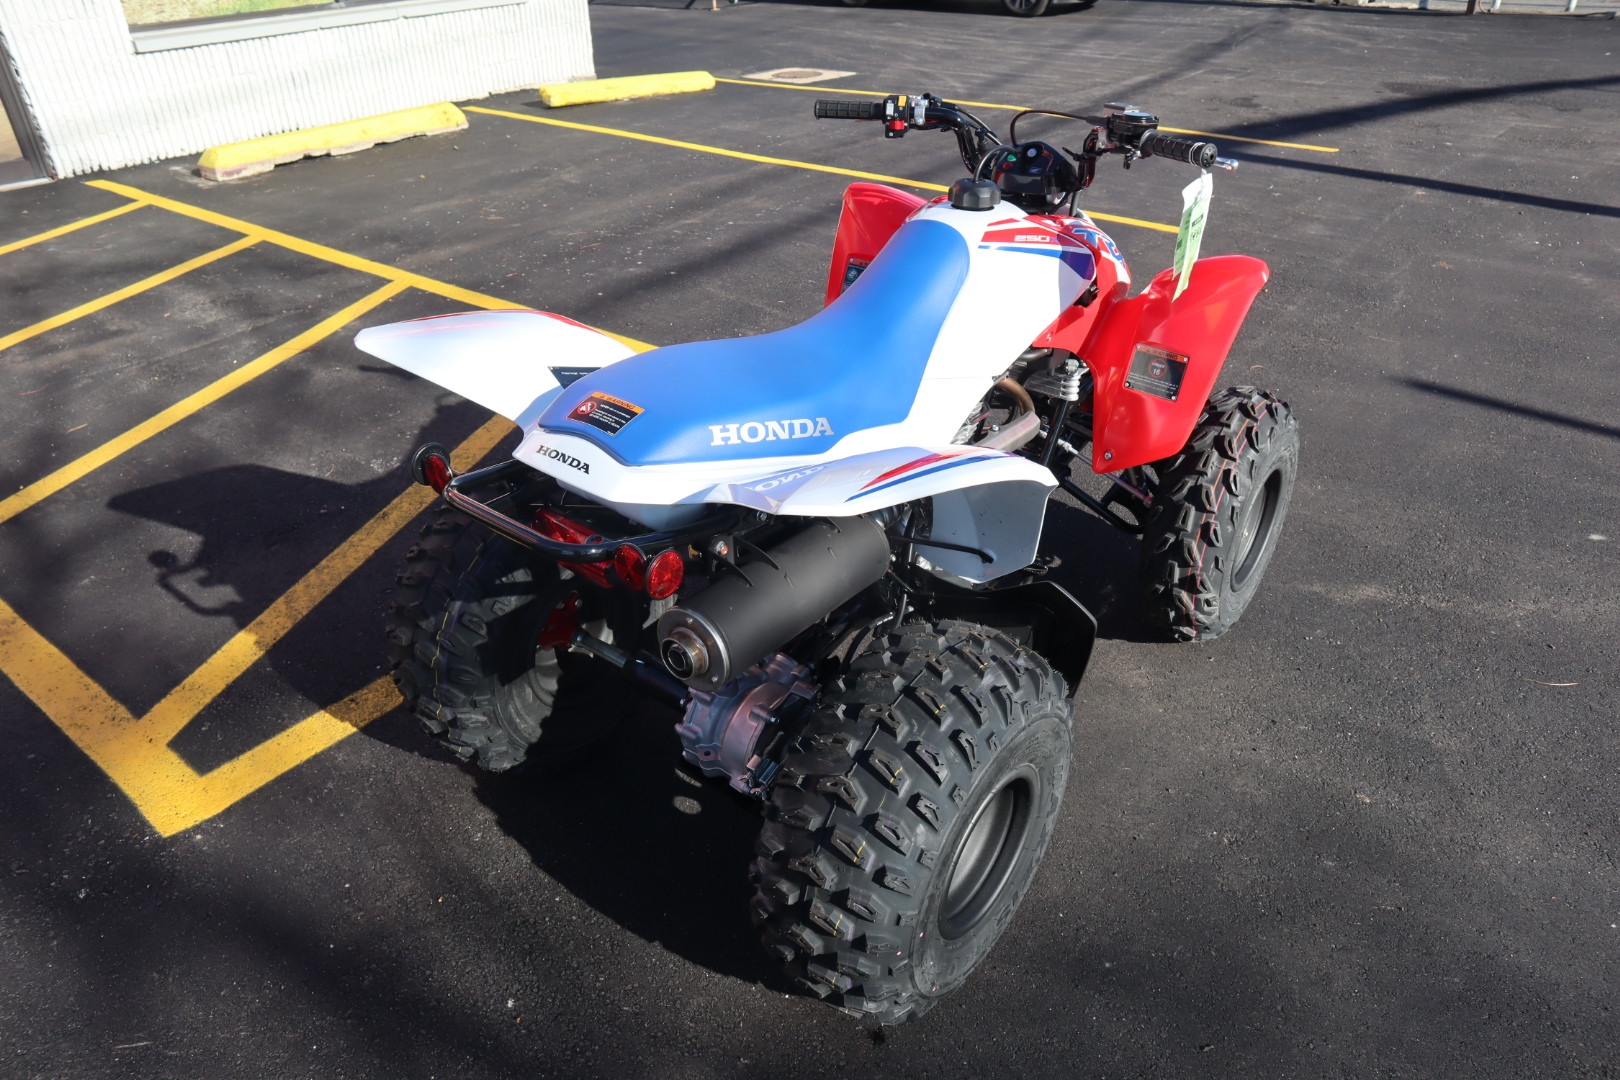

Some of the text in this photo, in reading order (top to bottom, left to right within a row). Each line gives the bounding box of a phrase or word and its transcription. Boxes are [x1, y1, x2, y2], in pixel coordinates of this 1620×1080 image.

[1153, 368, 1161, 376] 16
[708, 417, 834, 446] HONDA
[536, 445, 590, 474] HONDA
